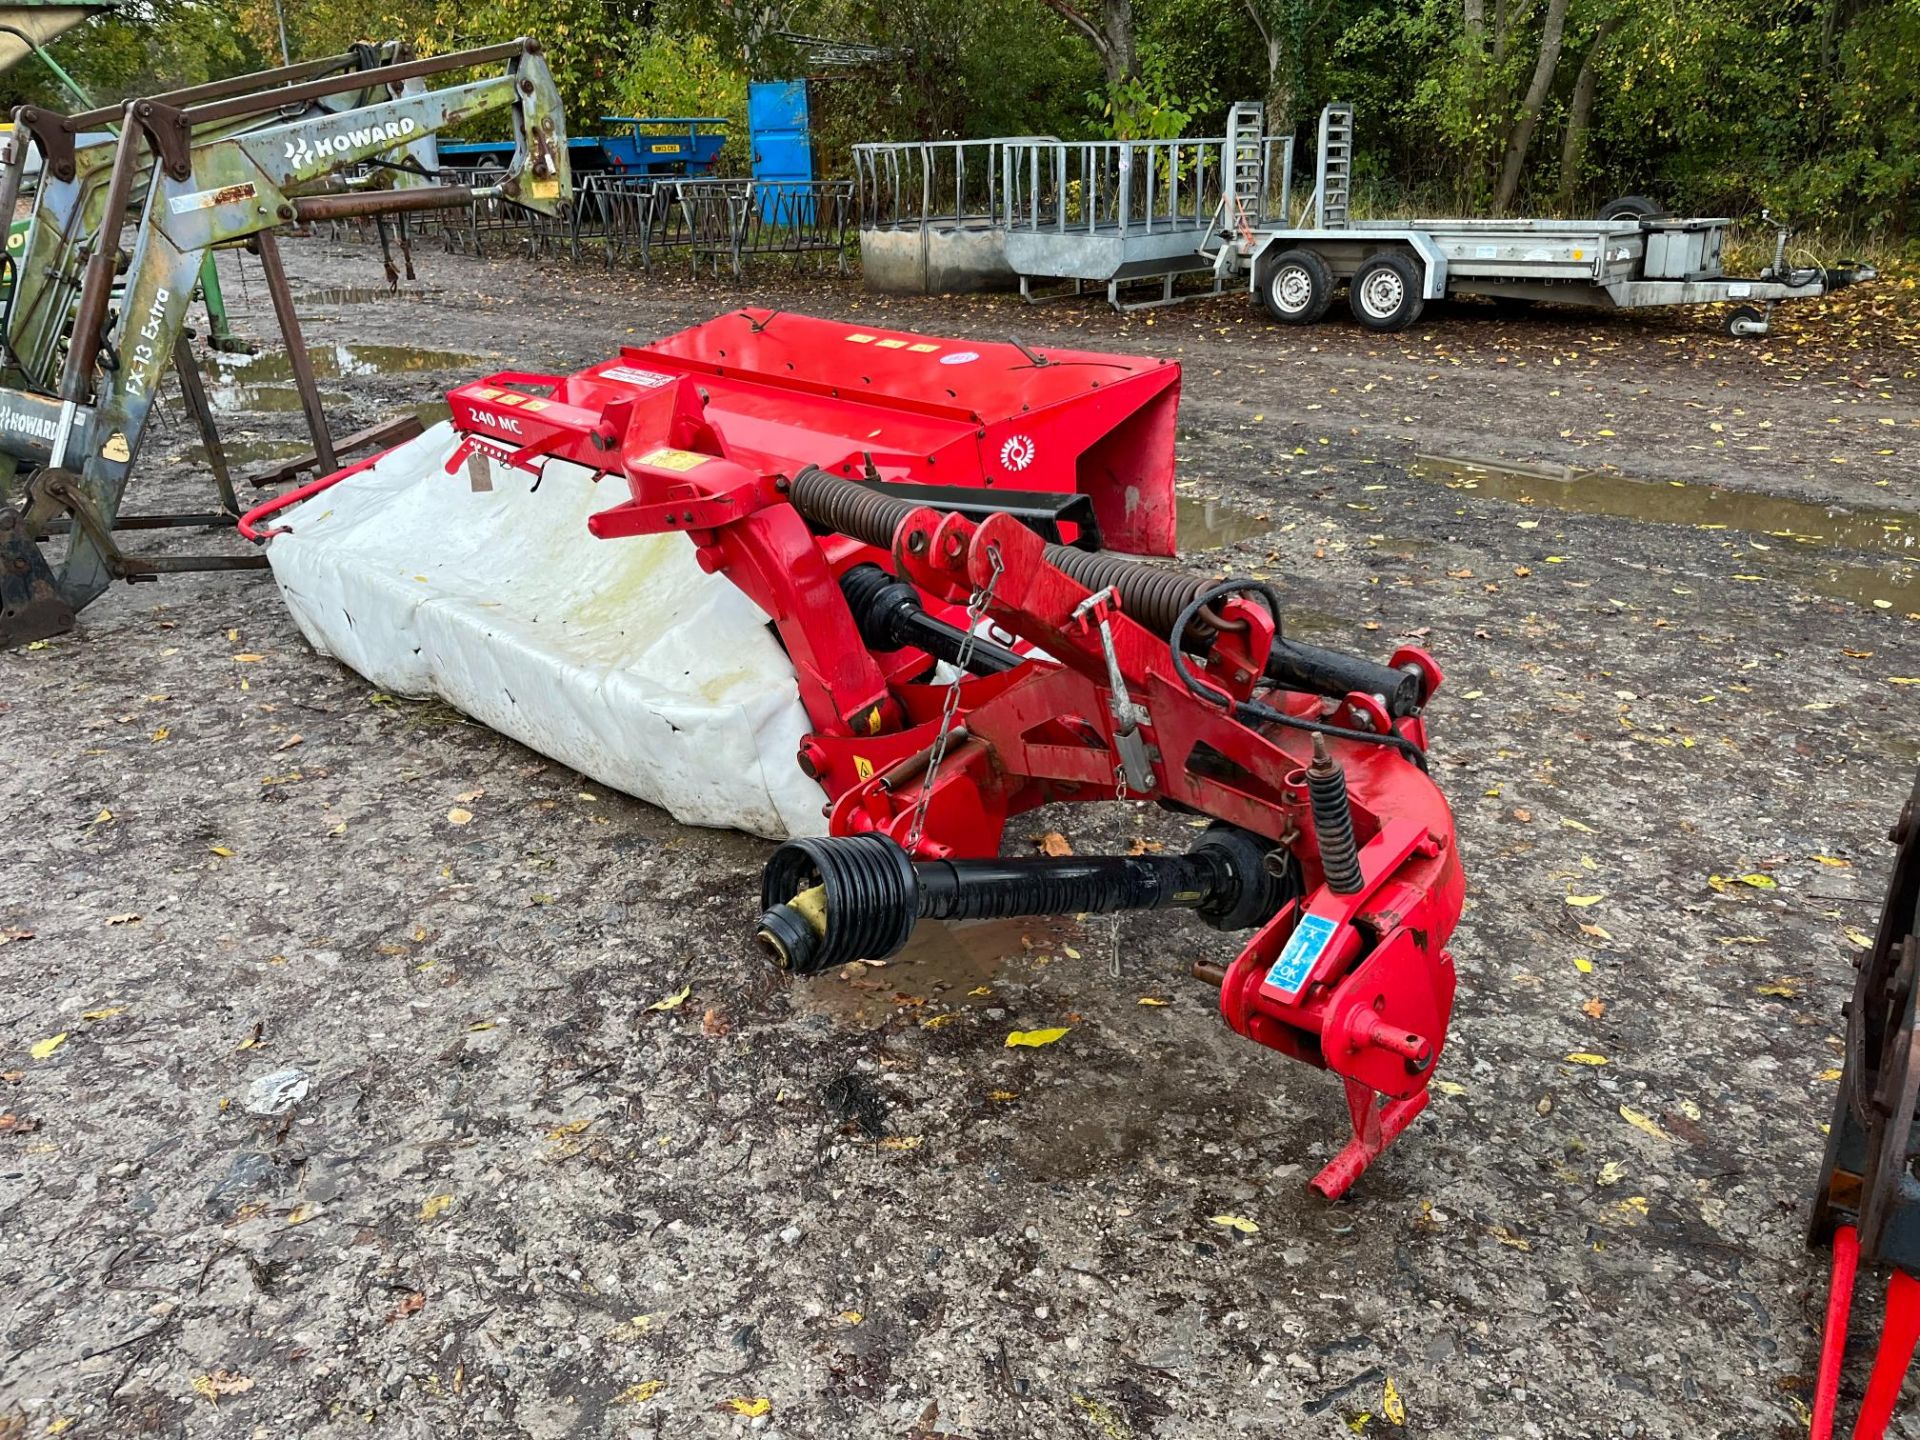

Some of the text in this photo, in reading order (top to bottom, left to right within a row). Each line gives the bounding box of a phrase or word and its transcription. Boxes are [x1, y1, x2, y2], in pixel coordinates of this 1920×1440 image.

[314, 117, 415, 158] HOWARD
[125, 288, 169, 396] FX-13 Extra
[468, 407, 523, 435] 240 MC
[1279, 966, 1299, 979] OK
